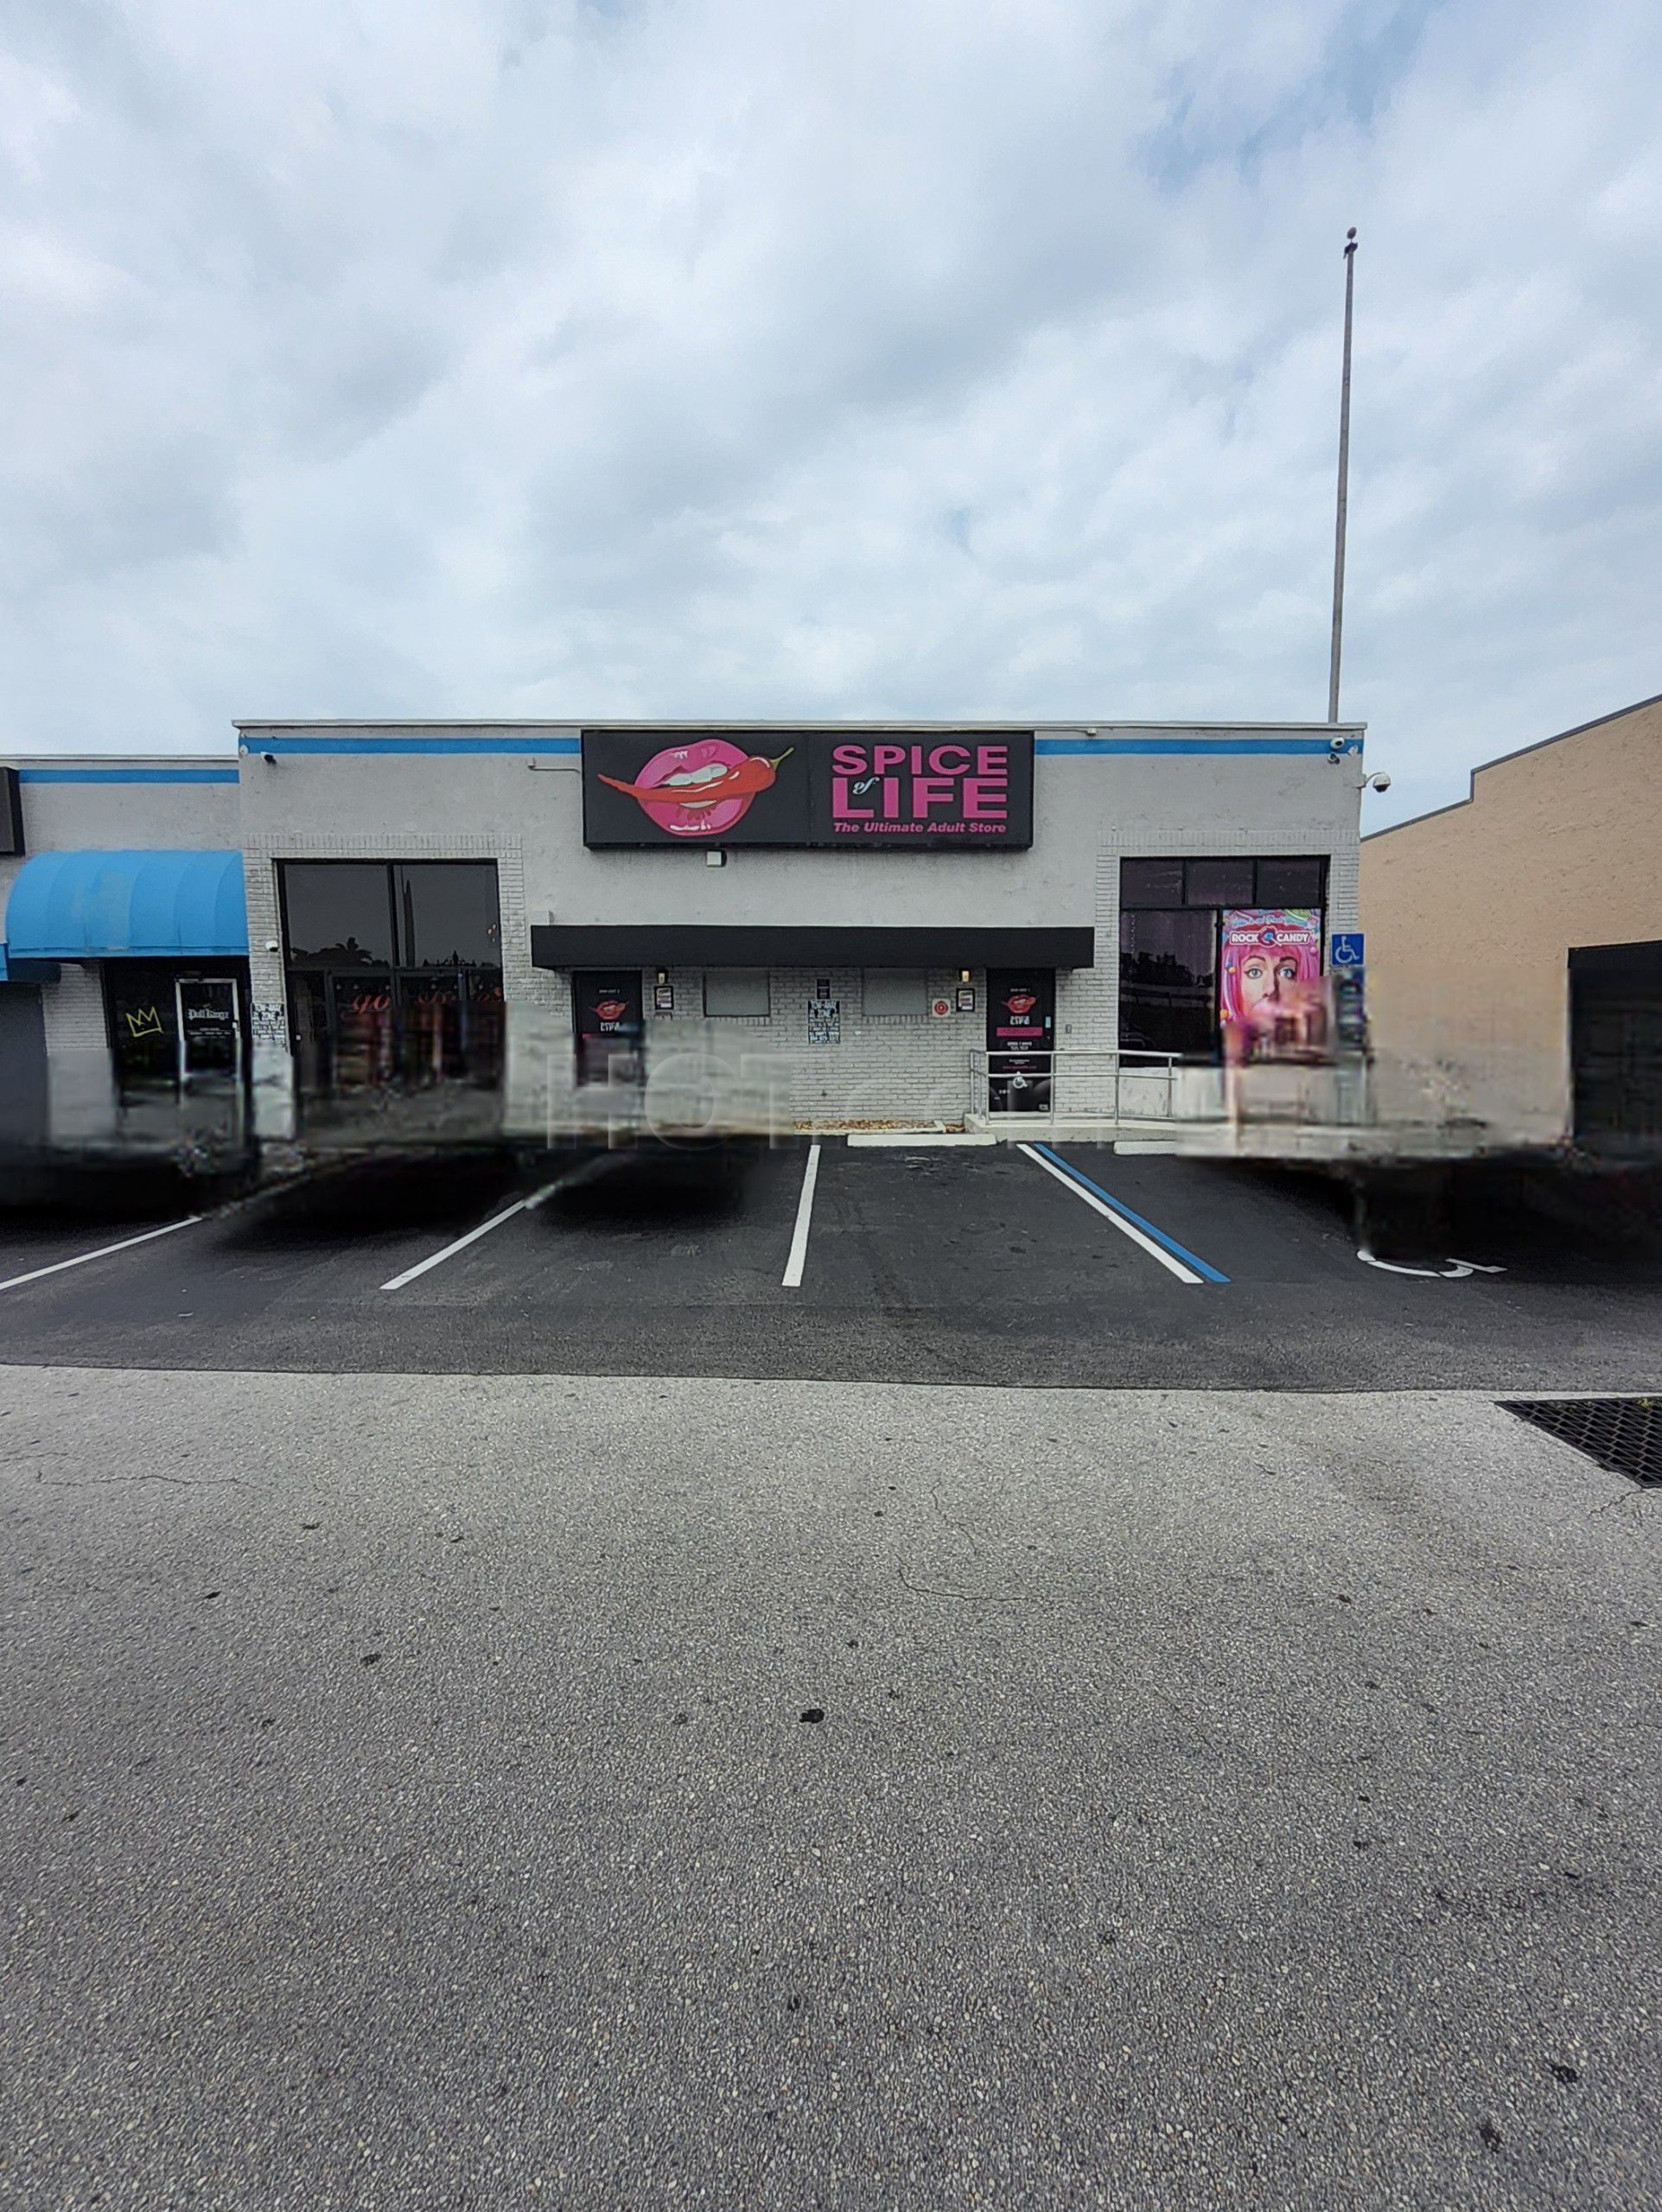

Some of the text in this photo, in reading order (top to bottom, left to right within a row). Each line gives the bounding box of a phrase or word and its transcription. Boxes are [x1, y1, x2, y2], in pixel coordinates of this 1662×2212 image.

[831, 745, 1009, 775] SPICE
[852, 776, 880, 795] of
[832, 777, 1009, 819] LIFE
[834, 823, 1006, 833] The Ultimate Adult Store
[1231, 933, 1309, 943] ROCK CANDY
